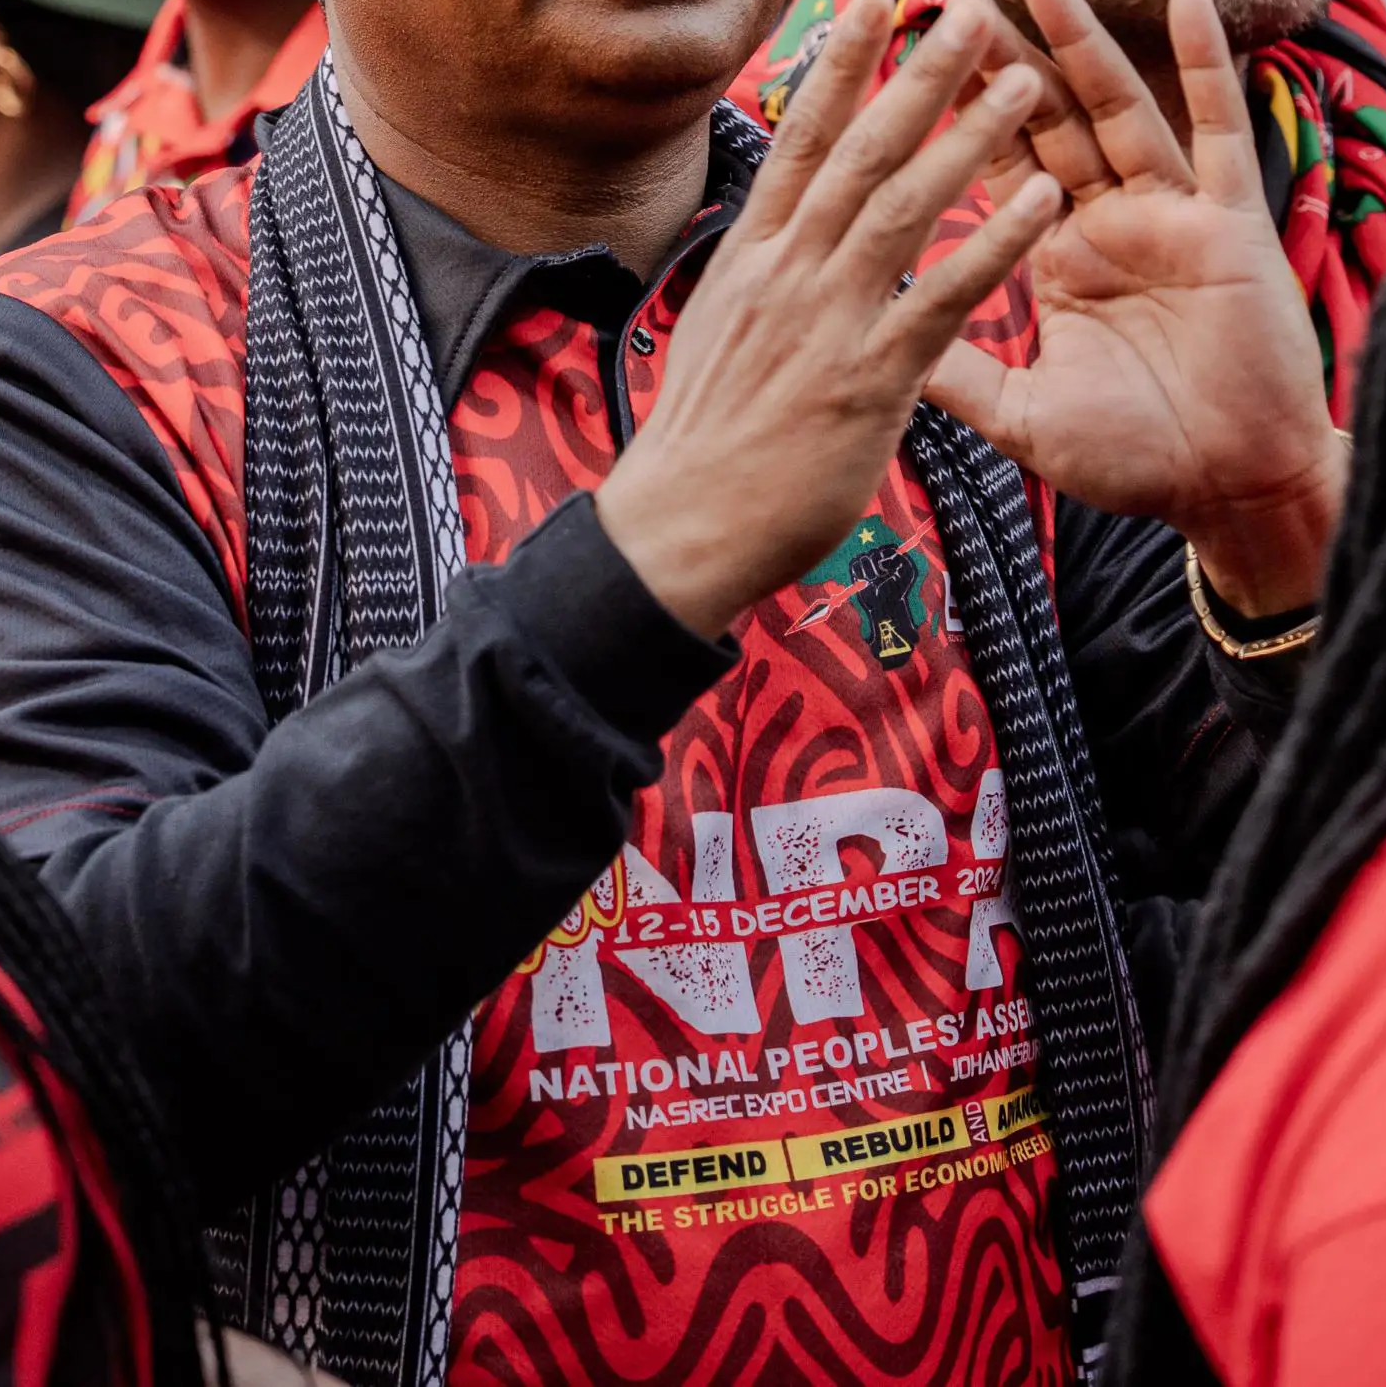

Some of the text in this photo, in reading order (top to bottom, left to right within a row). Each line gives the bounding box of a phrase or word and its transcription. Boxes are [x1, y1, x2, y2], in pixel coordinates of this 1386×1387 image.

[614, 908, 720, 944] 12-15
[731, 876, 941, 936] DECEMBER
[529, 1050, 758, 1102] NATIONAL
[765, 1011, 966, 1080] PEOPLES'
[625, 1094, 742, 1130] NASREC
[744, 1088, 807, 1118] EXPO
[811, 1068, 912, 1109] CENTRE
[621, 1150, 767, 1191] DEFEND
[820, 1116, 955, 1166] REBUILD
[965, 1101, 989, 1143] AND
[598, 1208, 664, 1236] THE
[674, 1187, 834, 1228] STRUGGLE
[841, 1175, 897, 1204] FOR
